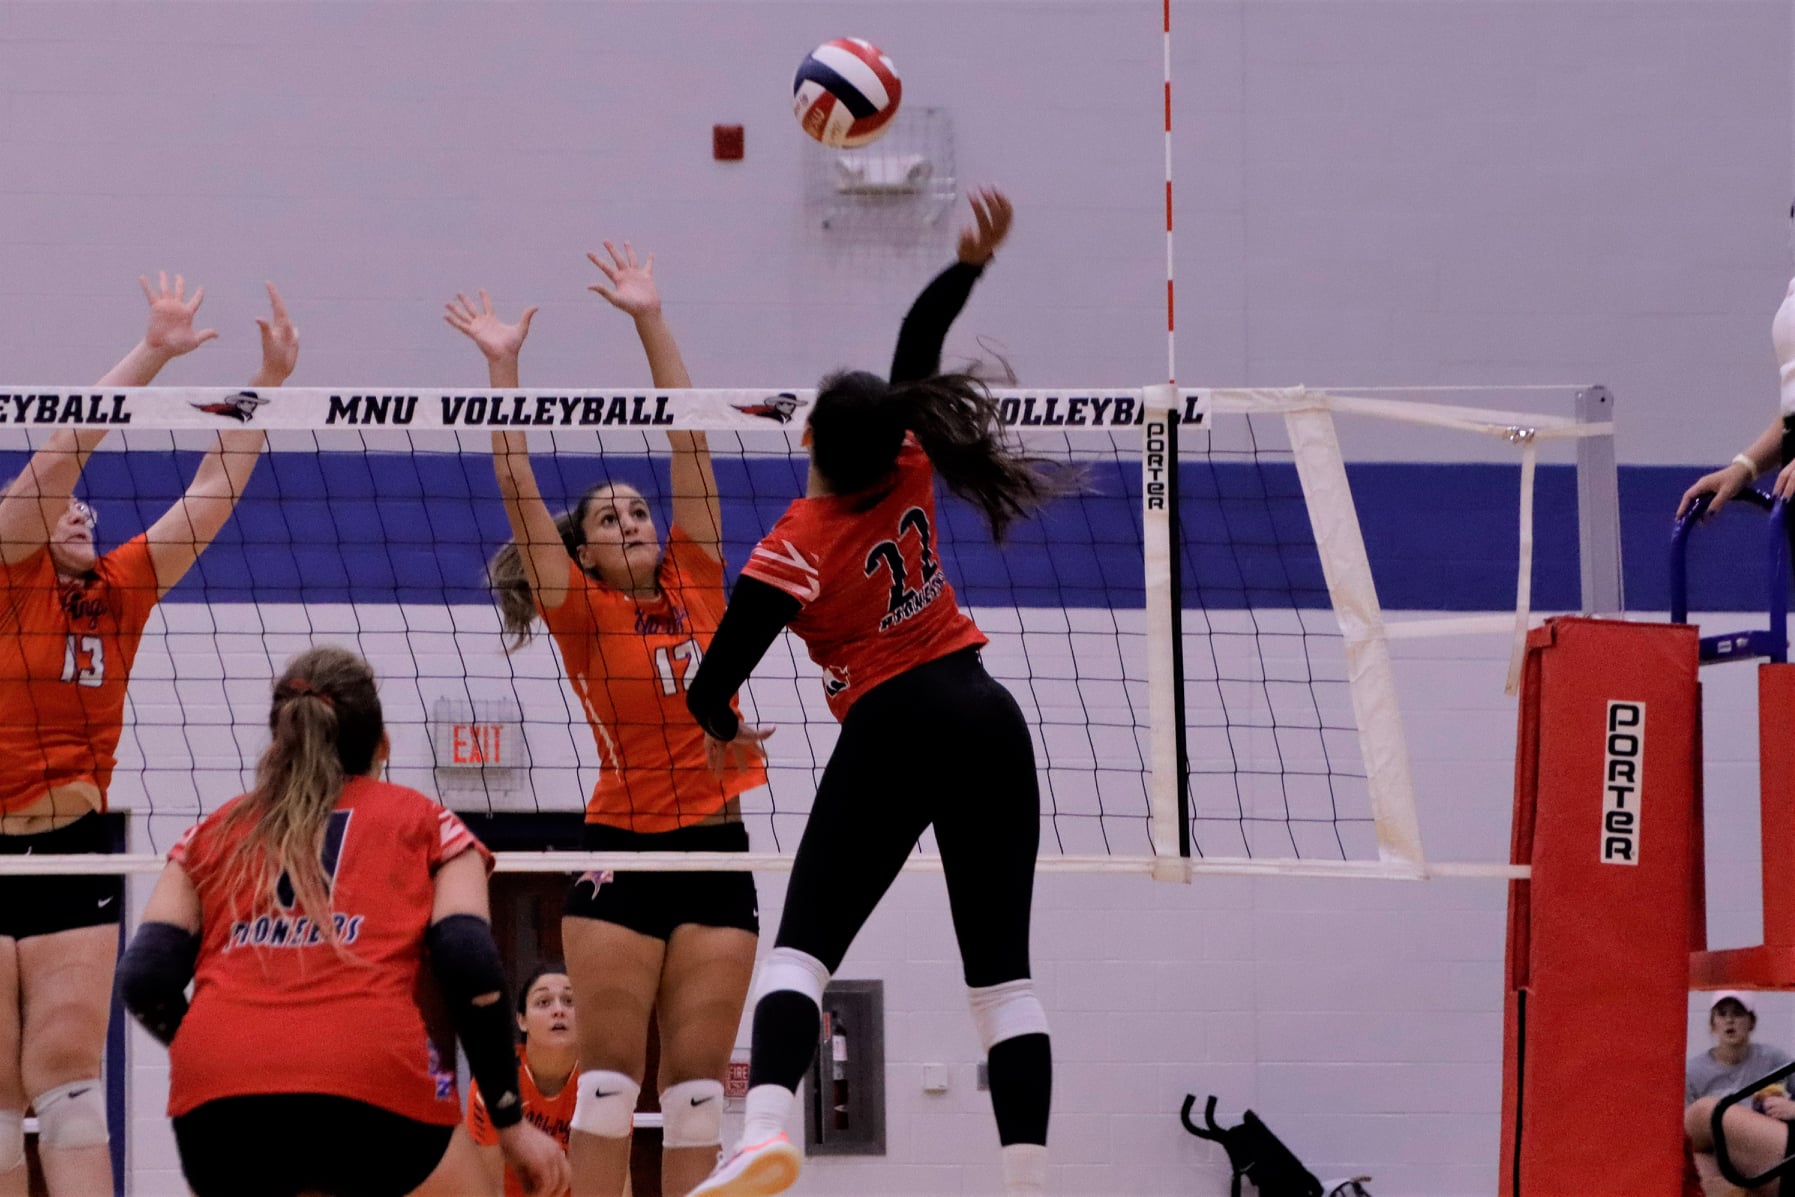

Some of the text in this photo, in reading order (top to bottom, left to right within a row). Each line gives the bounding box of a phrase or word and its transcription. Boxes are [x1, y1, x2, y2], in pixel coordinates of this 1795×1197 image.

[325, 395, 675, 426] MNU VOLLEYBALL
[863, 506, 938, 612] 22
[60, 634, 105, 688] 13
[453, 725, 504, 763] EXIT
